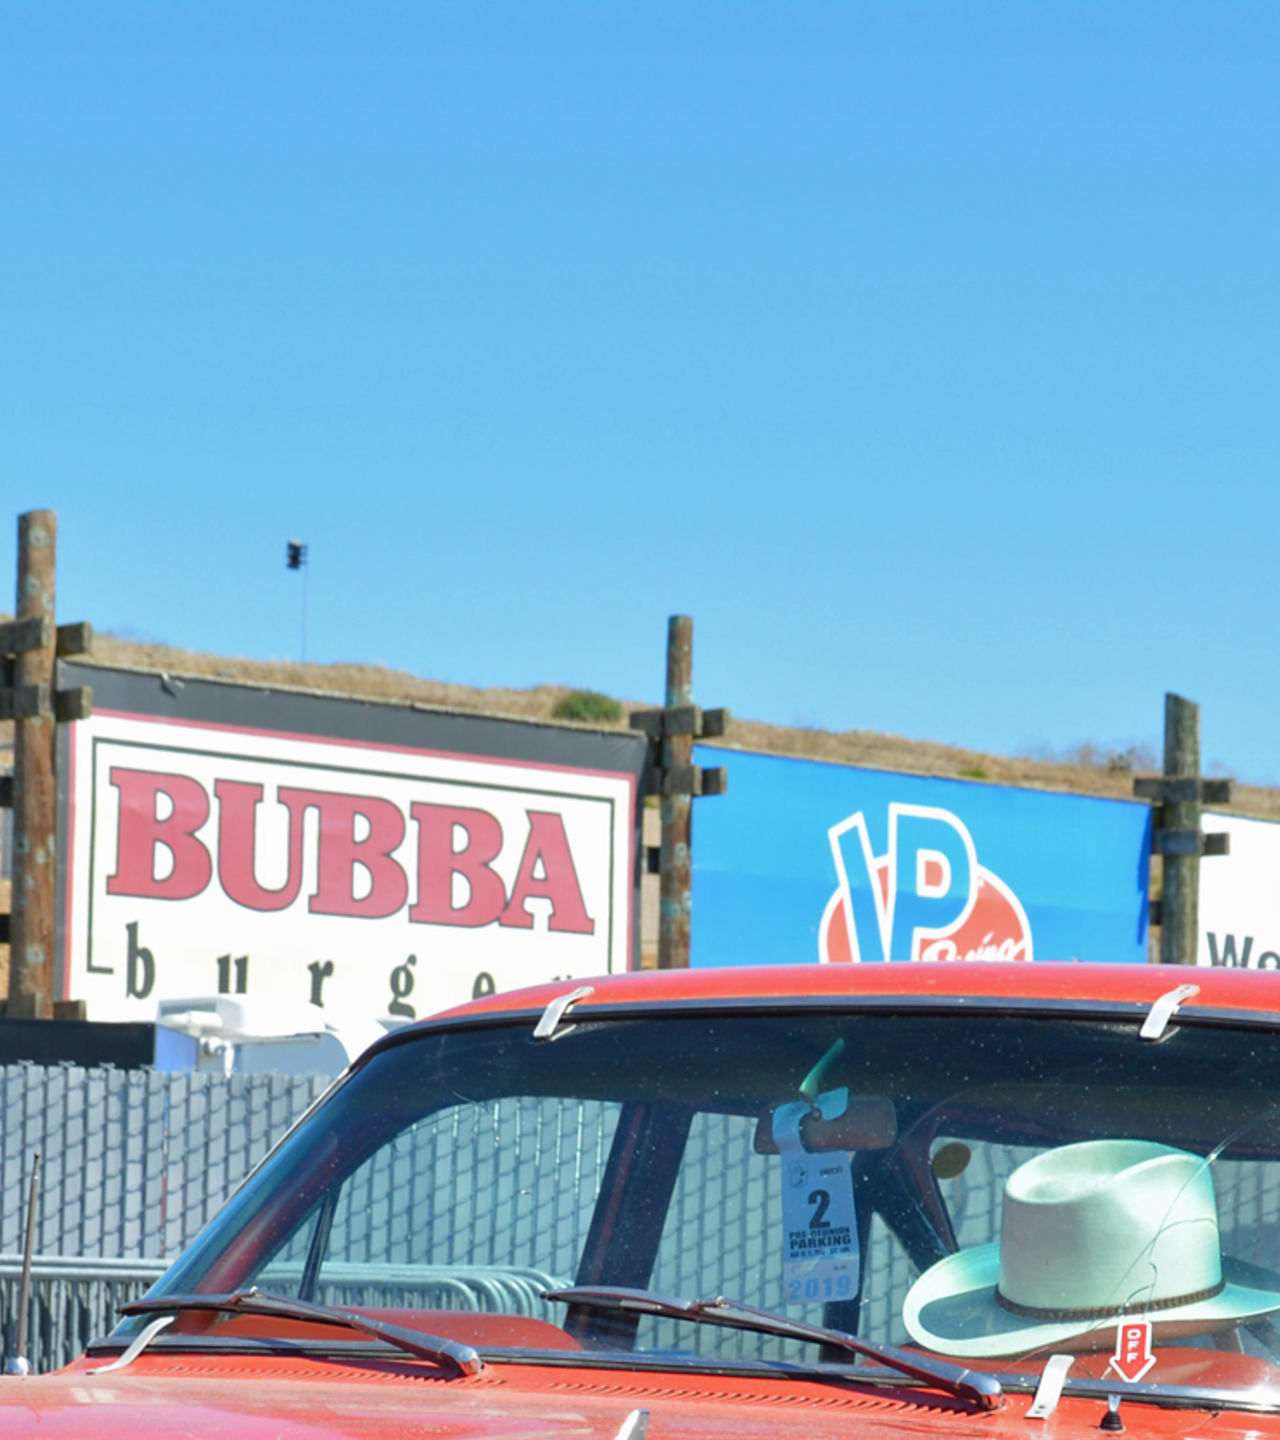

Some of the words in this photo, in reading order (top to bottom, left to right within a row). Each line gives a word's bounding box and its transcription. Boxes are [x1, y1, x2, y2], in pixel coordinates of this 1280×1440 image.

[106, 765, 595, 935] BUBBA
[827, 801, 979, 962] VP
[126, 921, 574, 1022] burge
[808, 1189, 831, 1229] 2
[789, 1234, 852, 1250] PARKING
[788, 1275, 851, 1301] 2019
[1126, 1328, 1142, 1364] OFF
